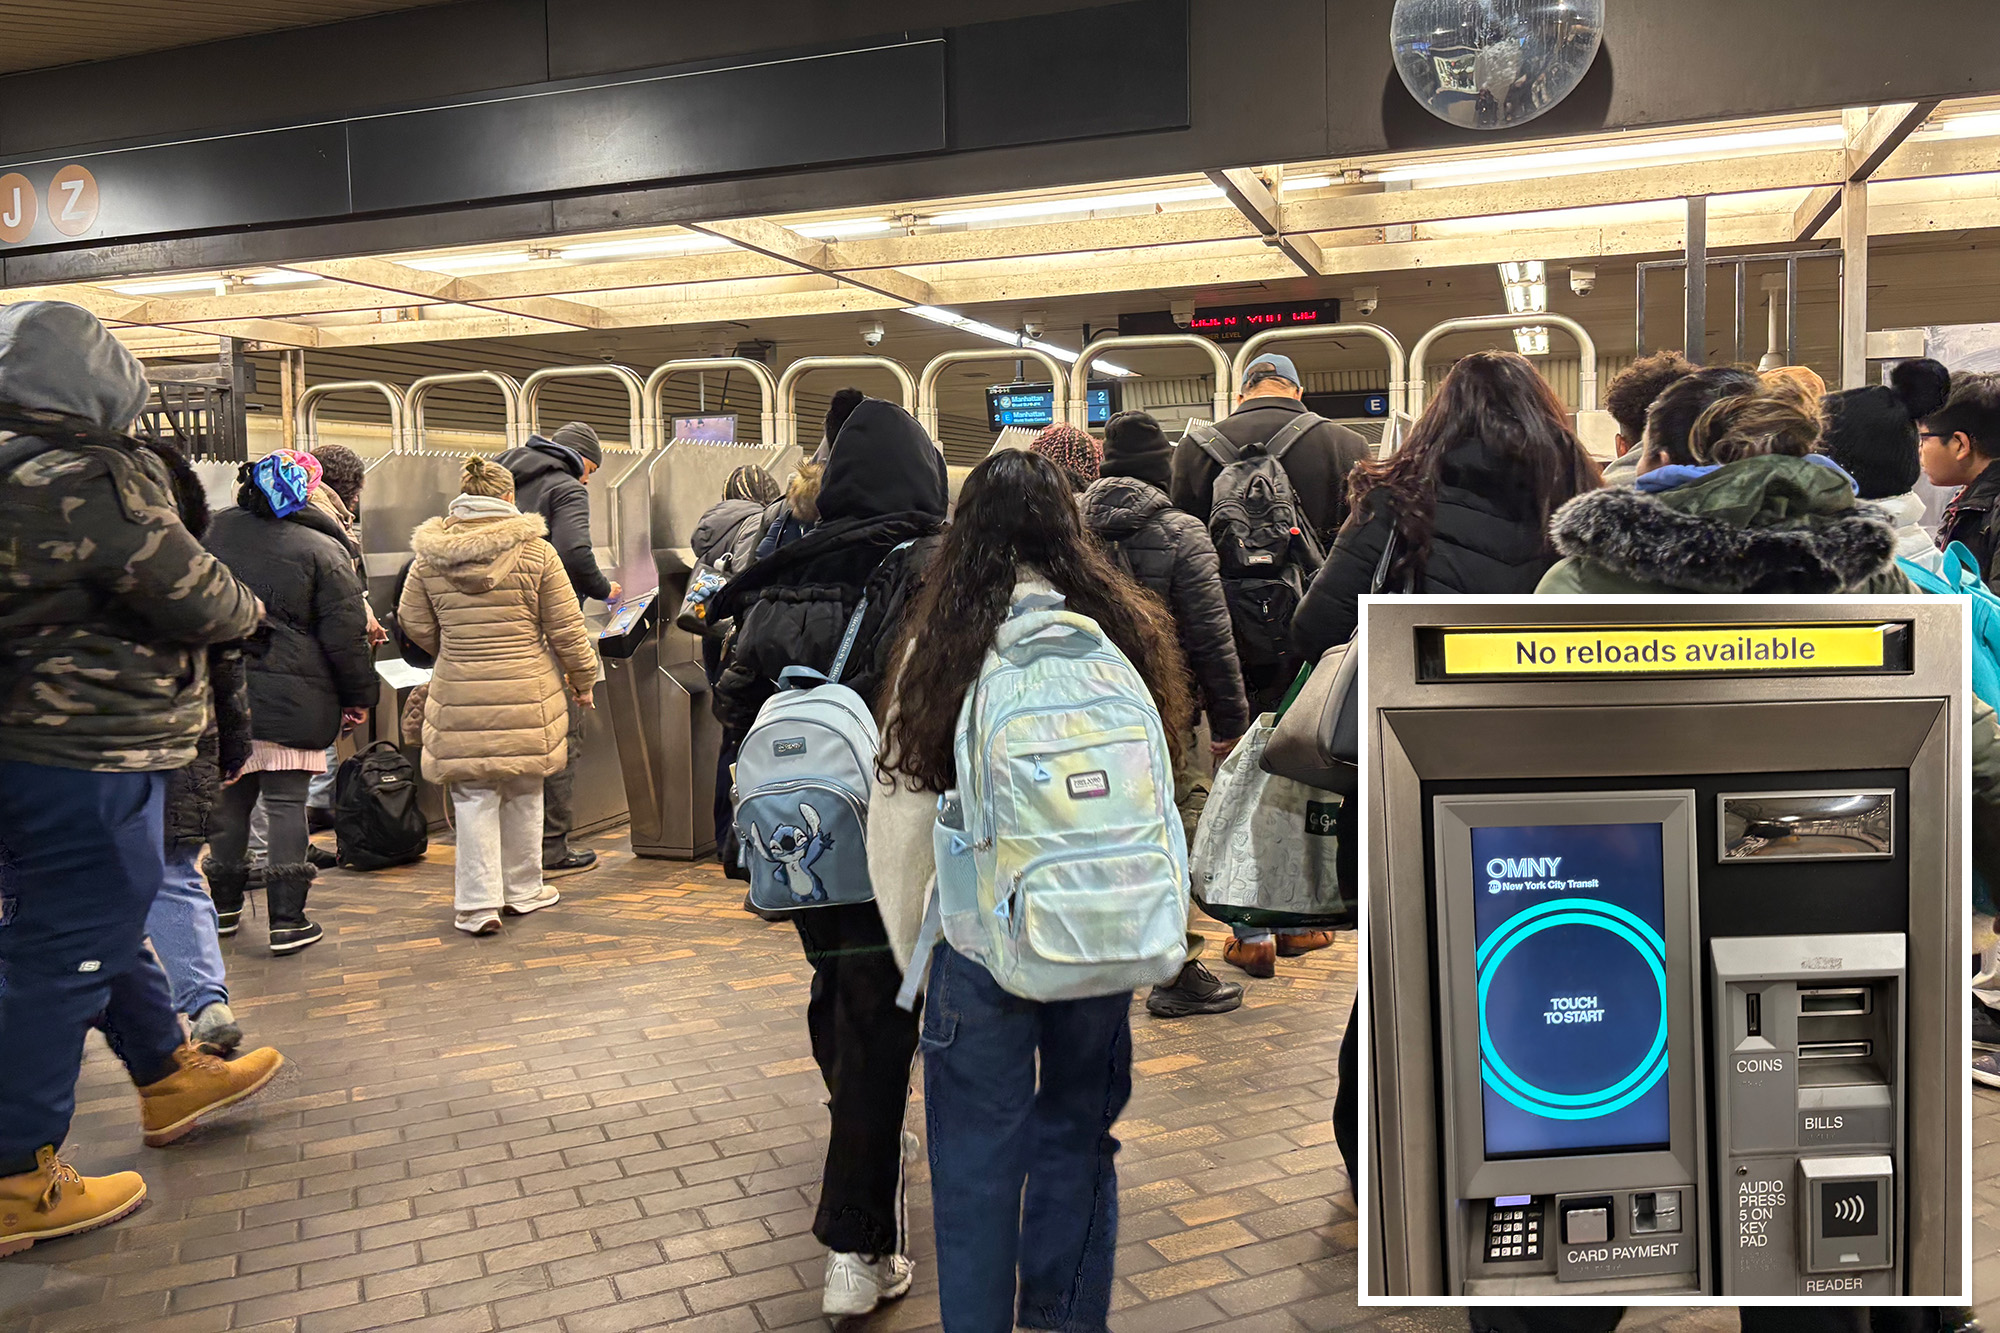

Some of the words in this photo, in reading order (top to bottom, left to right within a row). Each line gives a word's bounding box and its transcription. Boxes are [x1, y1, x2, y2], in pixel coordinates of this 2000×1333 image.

[3, 187, 21, 228] J
[61, 179, 87, 221] Z
[1221, 331, 1242, 339] LEVEL
[1011, 395, 1044, 403] Manhattan
[1098, 391, 1105, 401] 2
[1099, 407, 1107, 417] 4
[1370, 399, 1381, 411] E
[1516, 640, 1556, 665] No
[1566, 639, 1677, 664] reloads
[1685, 637, 1816, 662] available
[830, 661, 842, 683] Stitc
[1486, 857, 1562, 879] OMNY
[1502, 882, 1523, 891] New
[1524, 880, 1546, 890] York
[1547, 880, 1566, 890] City
[1566, 879, 1599, 889] Transit
[1550, 996, 1597, 1010] TOUCH
[1543, 1011, 1563, 1024] TO
[1563, 1009, 1605, 1024] START
[1736, 1059, 1783, 1073] COINS
[1804, 1116, 1843, 1130] BILLS
[1739, 1180, 1783, 1194] AUDIO
[1739, 1194, 1786, 1207] PRESS
[1739, 1209, 1747, 1221] 5
[1751, 1208, 1773, 1221] ON
[1740, 1221, 1767, 1234] KEY
[1740, 1235, 1768, 1248] PAD
[1567, 1248, 1608, 1263] CARD
[1612, 1243, 1679, 1260] PAYMENT
[1806, 1278, 1863, 1292] READER
